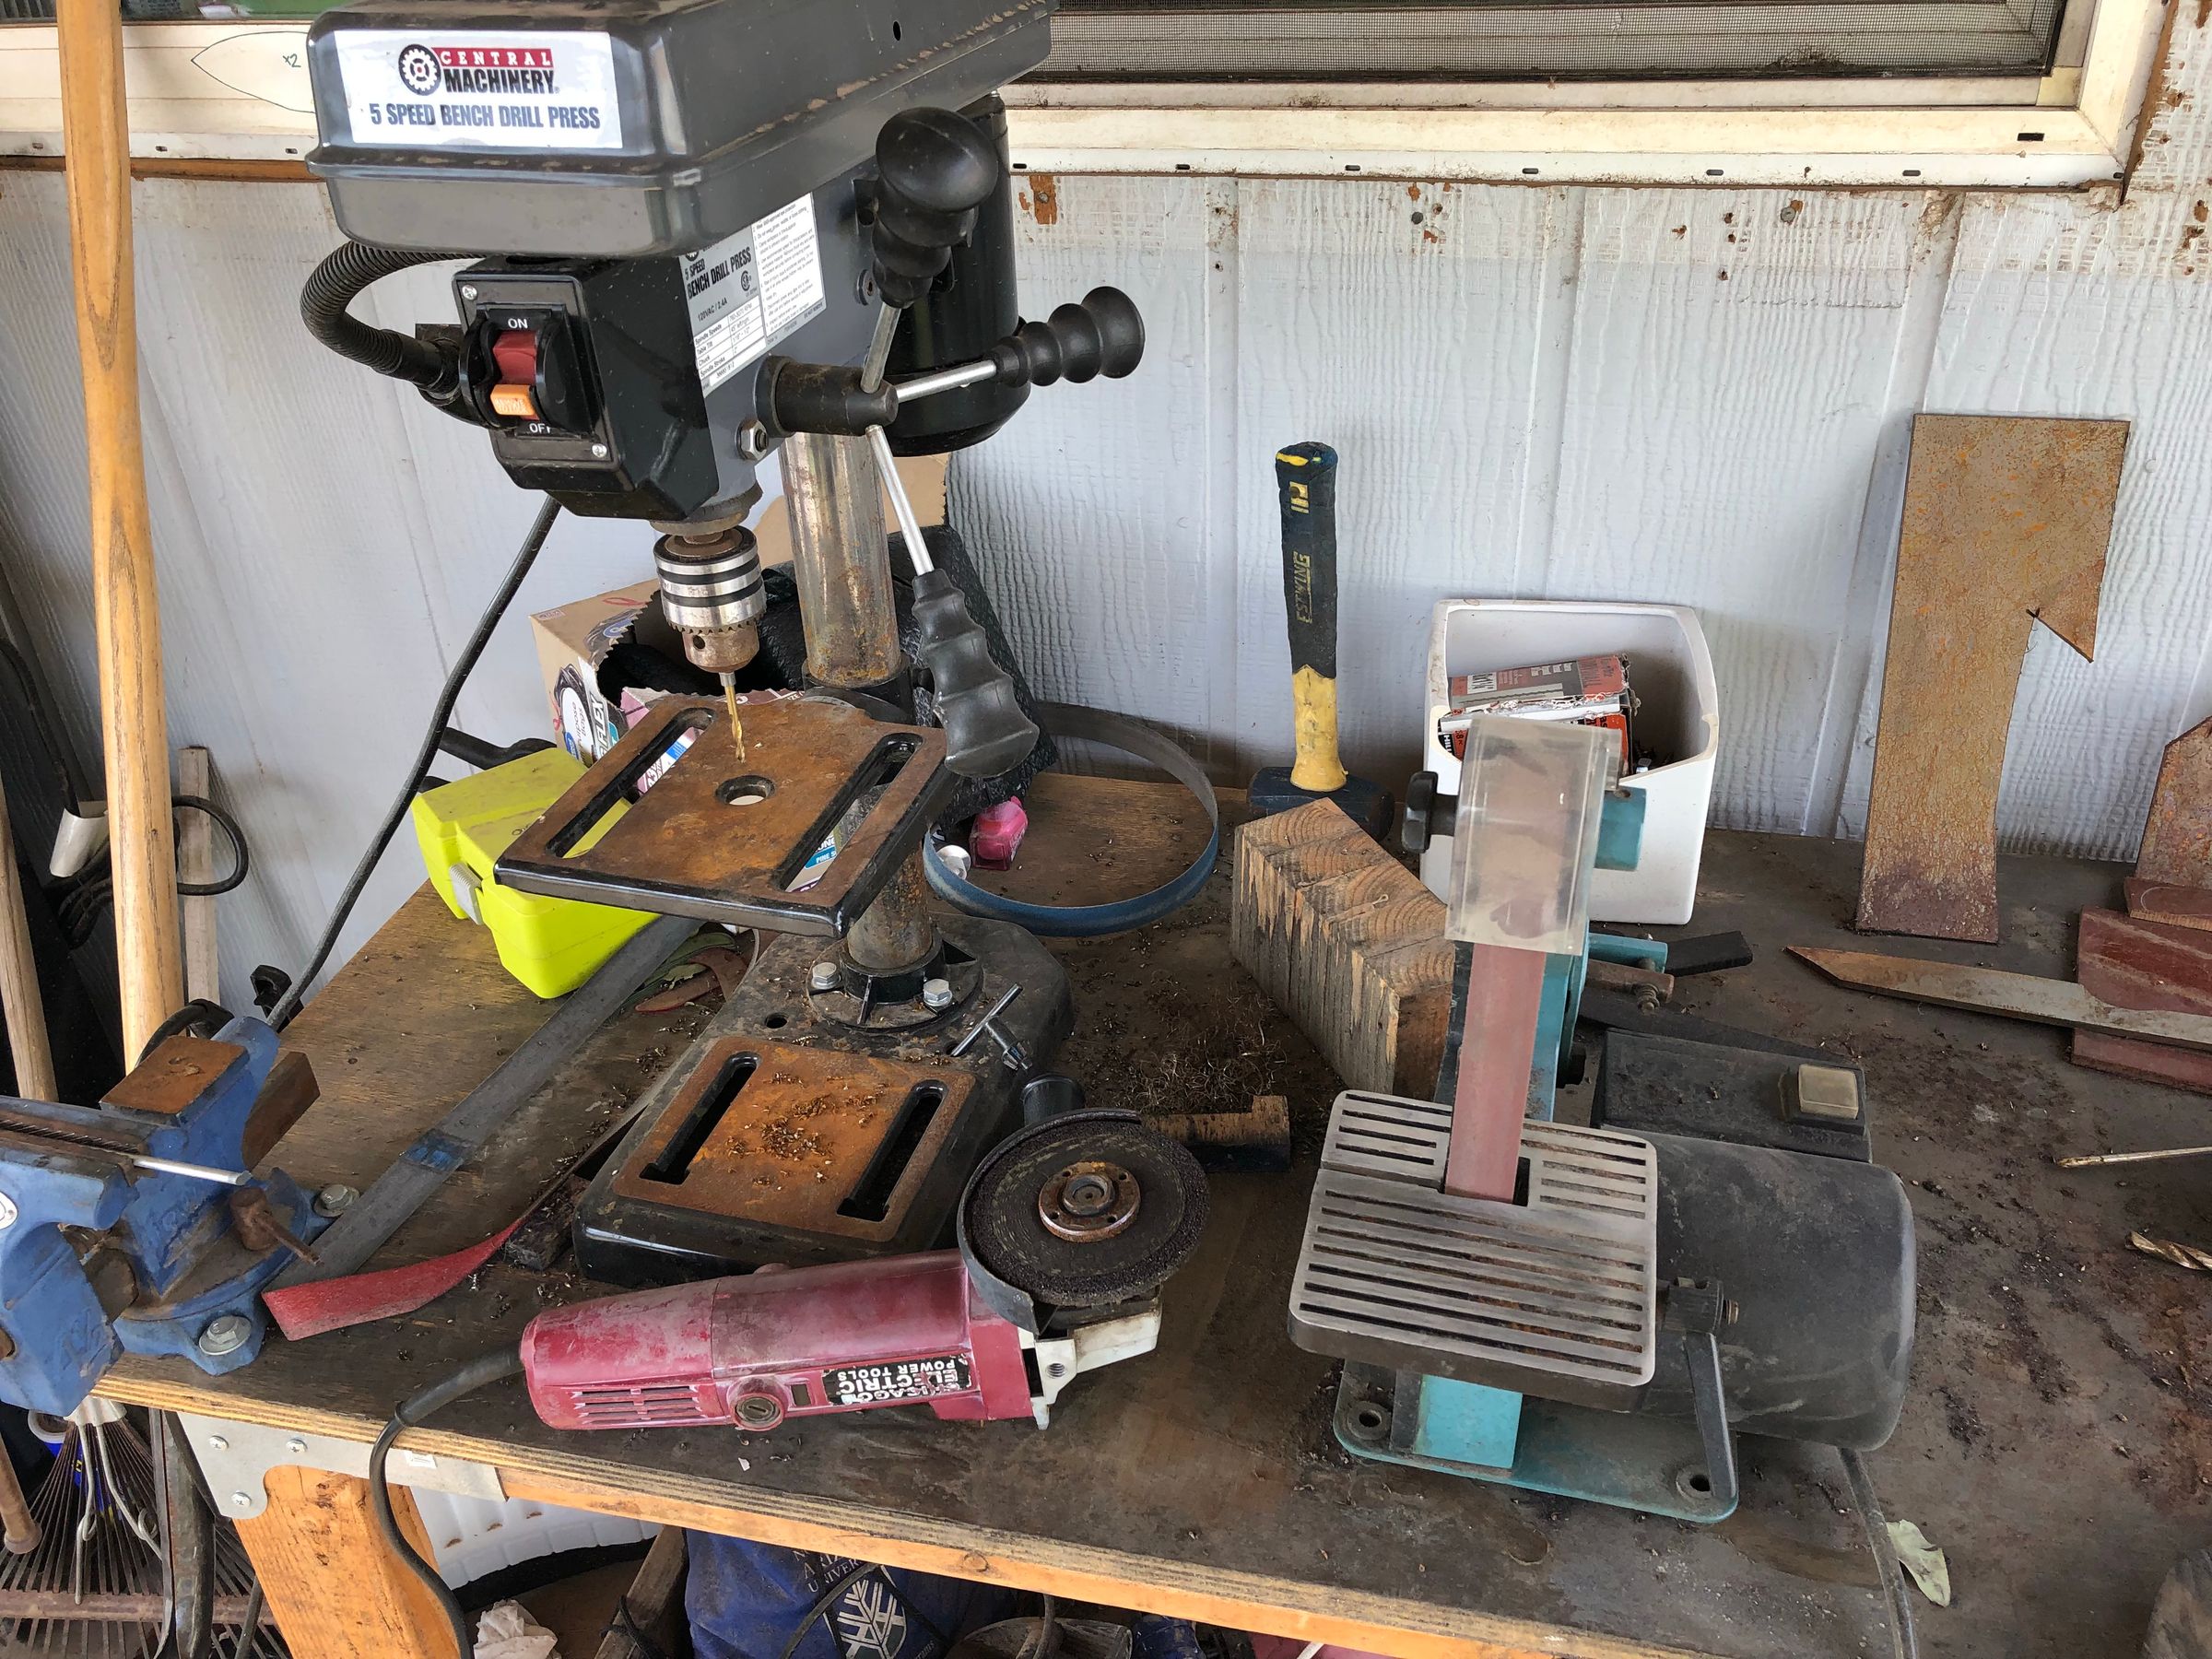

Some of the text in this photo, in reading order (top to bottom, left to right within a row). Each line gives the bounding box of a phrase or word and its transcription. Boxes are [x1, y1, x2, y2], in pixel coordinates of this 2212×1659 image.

[441, 49, 552, 66] CENTRAL
[443, 69, 554, 95] MACHINERY
[370, 103, 601, 130] 5 SPEED BENCH DRILL PRESS
[684, 258, 705, 281] 5 SPEED
[687, 246, 752, 300] BENCH DRILL PRESS
[508, 318, 528, 329] ON
[1292, 550, 1312, 624] ESTWING
[590, 691, 609, 747] FLEX
[837, 1359, 956, 1382] POWER TOOLS
[838, 1369, 959, 1394] ELECTRIC
